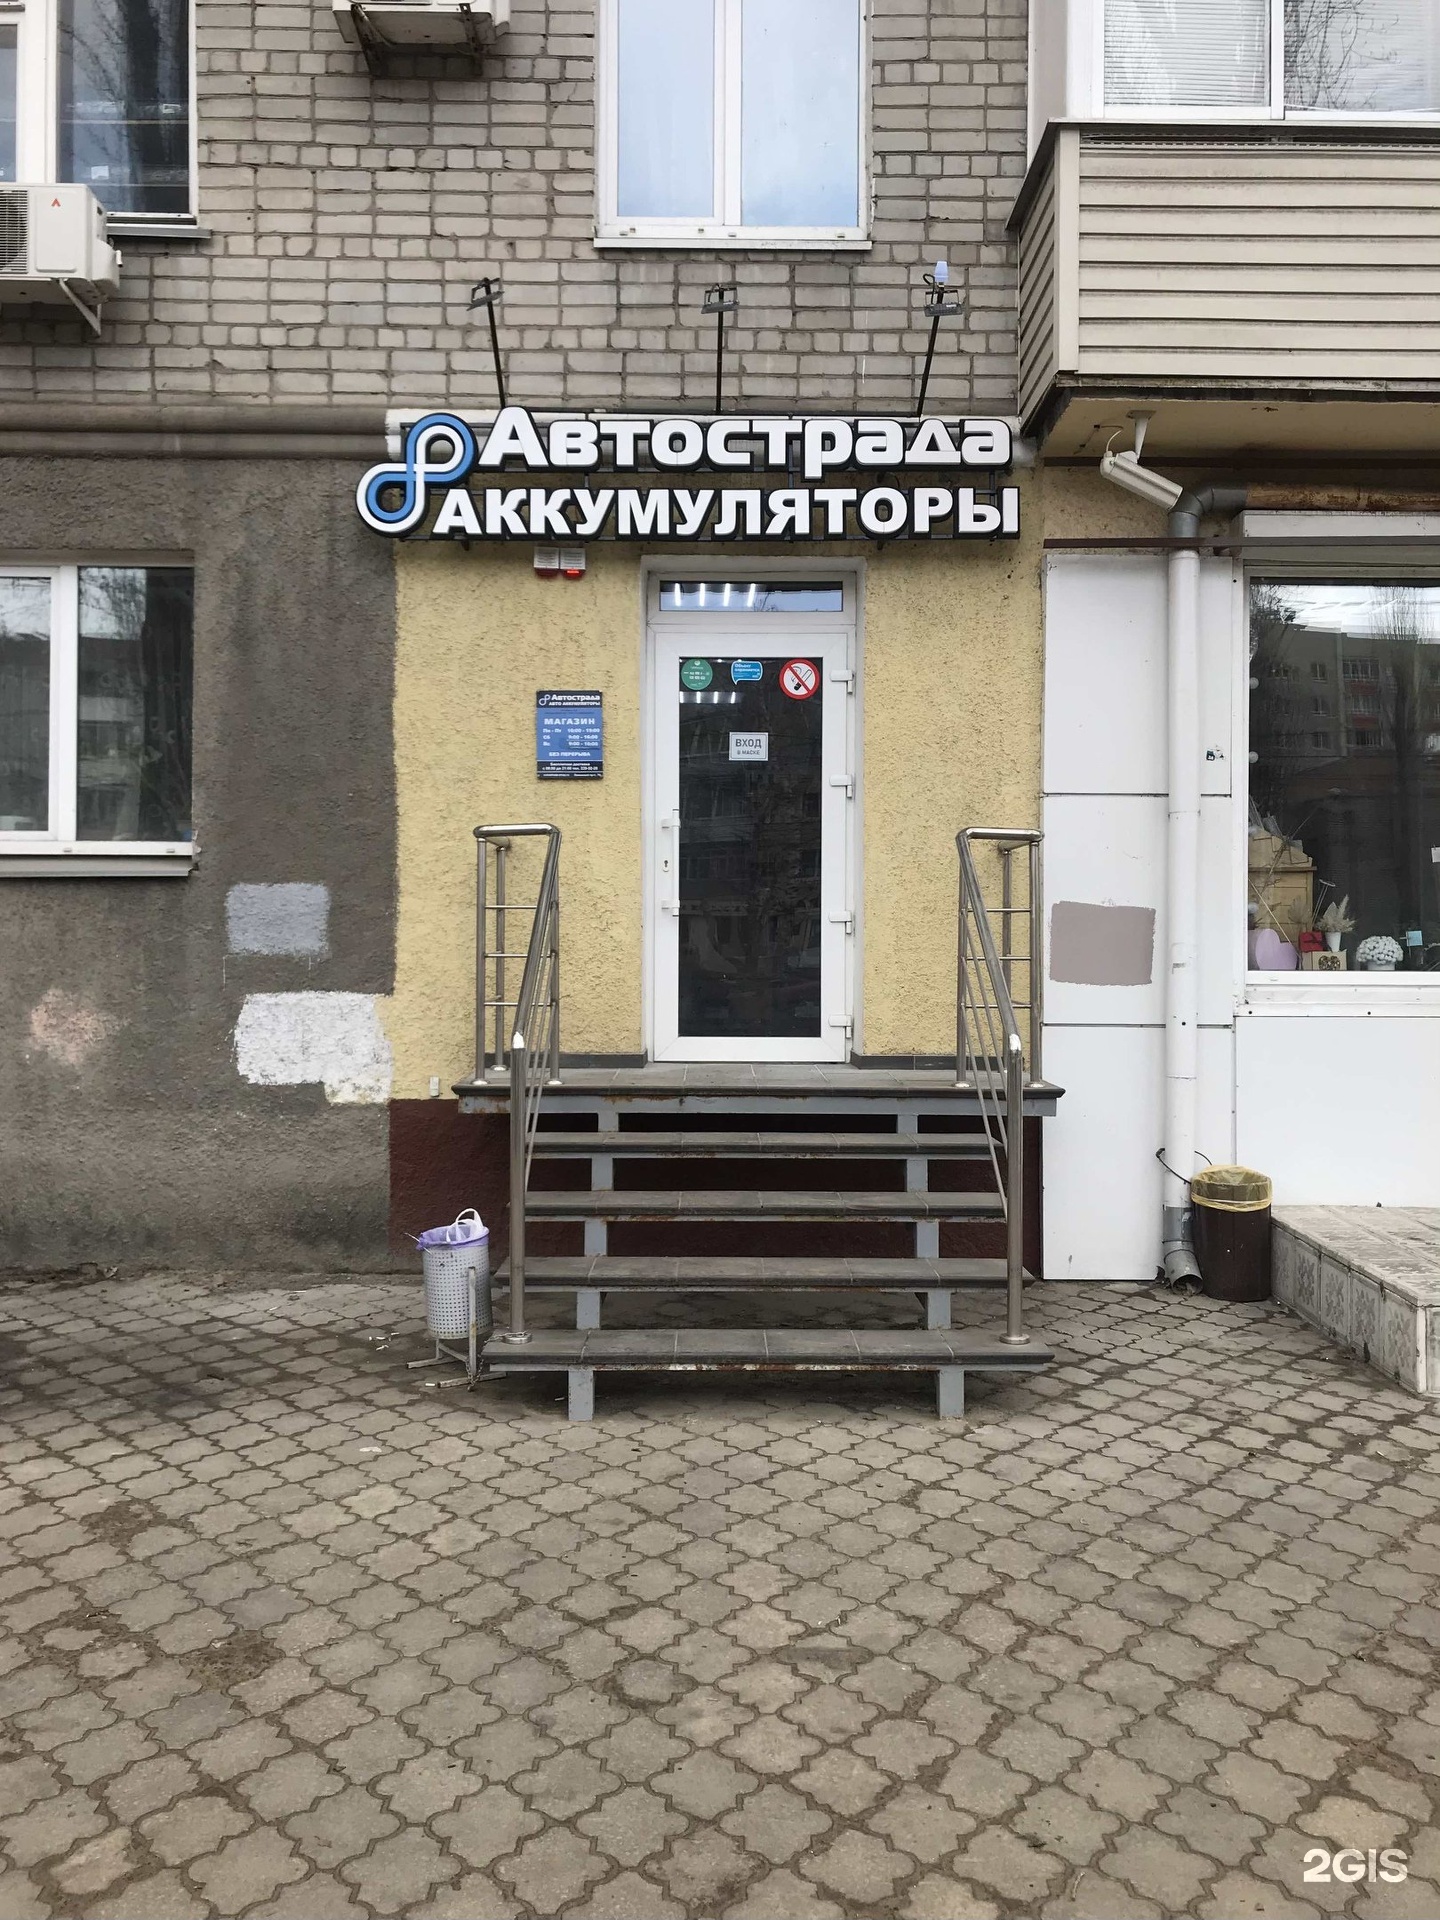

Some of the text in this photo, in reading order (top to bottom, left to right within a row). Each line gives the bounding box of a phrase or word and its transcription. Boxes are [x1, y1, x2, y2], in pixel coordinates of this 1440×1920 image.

[477, 406, 1011, 479] Автострада
[432, 487, 1019, 534] АККУМУЛЯТОРЫ
[551, 694, 600, 702] Автострада
[735, 738, 762, 749] ВХОД
